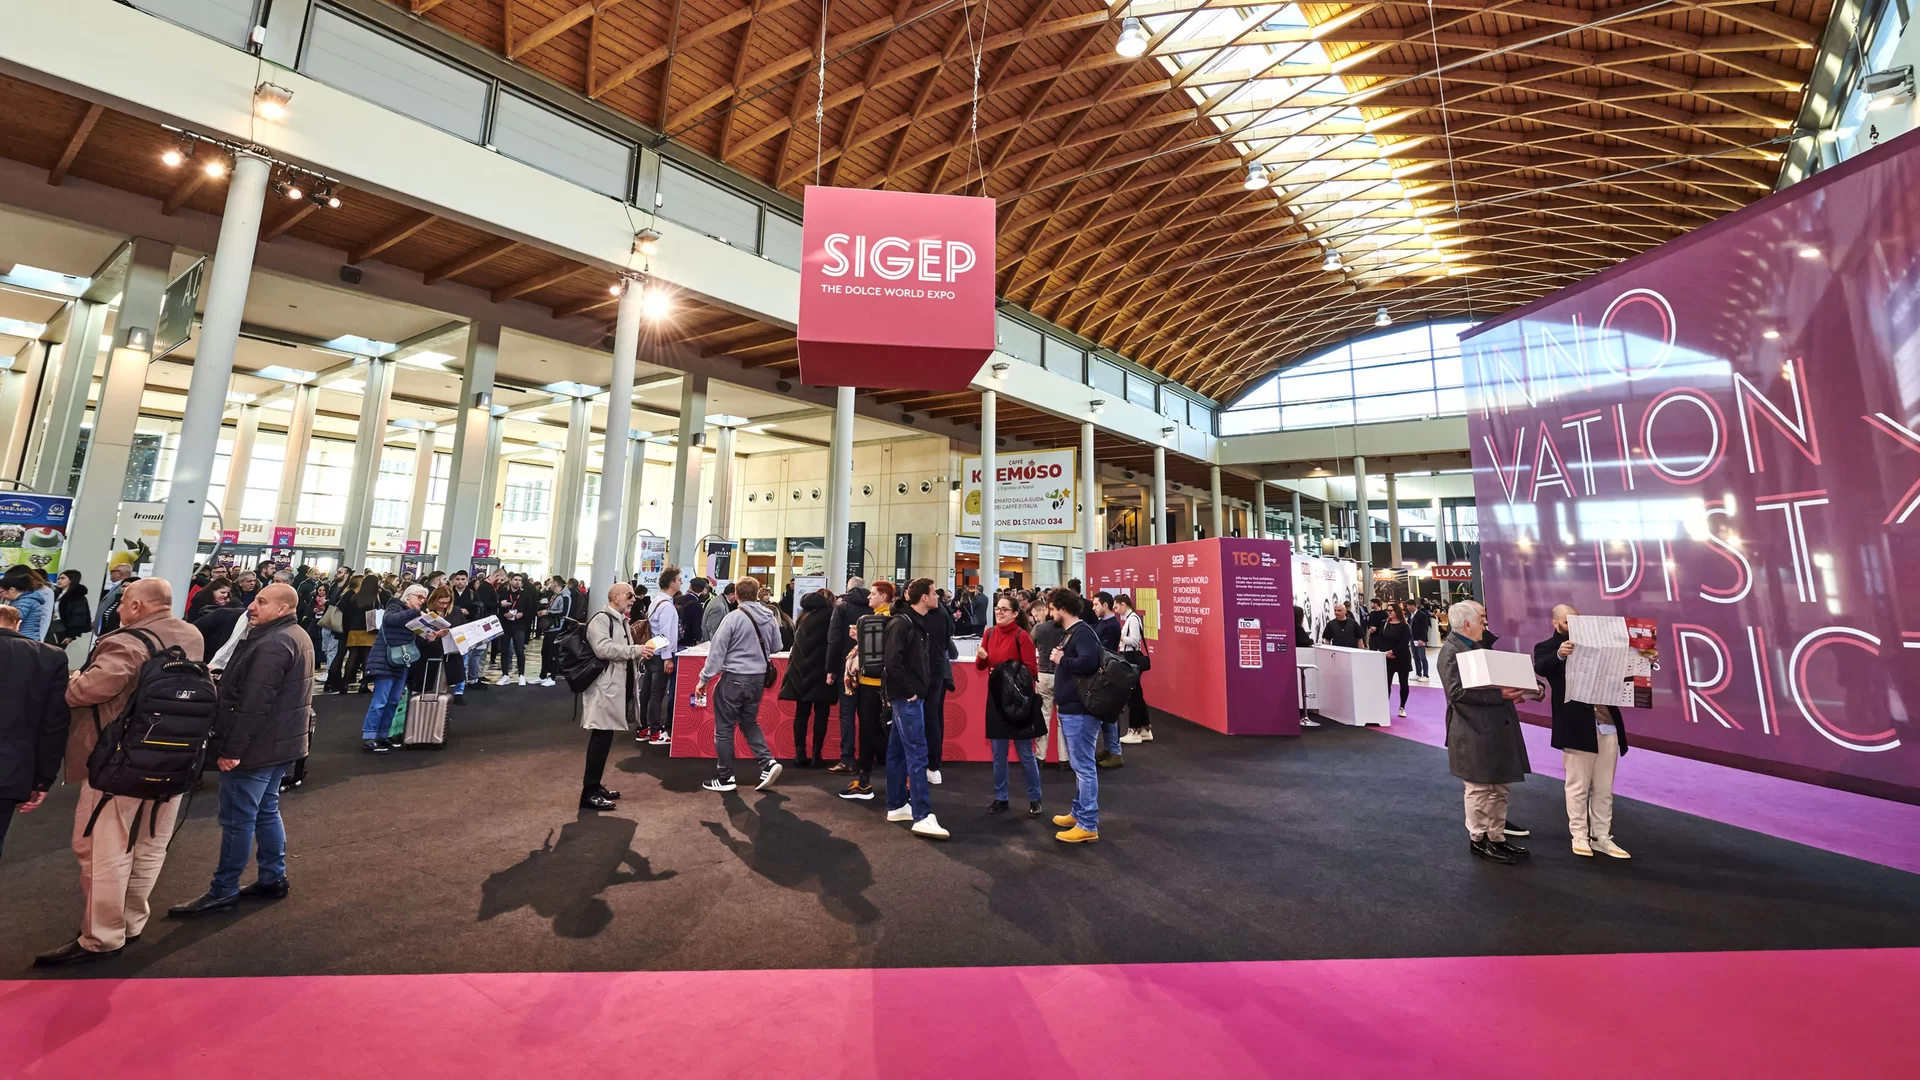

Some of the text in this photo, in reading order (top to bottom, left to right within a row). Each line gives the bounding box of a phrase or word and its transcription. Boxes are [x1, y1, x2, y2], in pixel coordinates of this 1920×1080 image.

[821, 233, 976, 283] SIGEP
[821, 284, 955, 300] THE DOLCE WORLD EXPO
[1474, 288, 1676, 420] INNO
[1484, 357, 1822, 504] VATION
[972, 463, 1062, 483] KEMOSO
[972, 519, 1011, 527] PAIONE
[1172, 555, 1184, 565] SIGEP
[1232, 552, 1260, 566] TEO
[1194, 576, 1209, 584] WORLD
[1173, 596, 1191, 604] FLAVOURS
[1174, 606, 1210, 615] DISCOVER THE NEXT
[1174, 615, 1203, 625] TASTE TO TEMPT
[1174, 625, 1184, 633] YOUR
[1672, 624, 1920, 752] RIC
[176, 690, 193, 699] CAT
